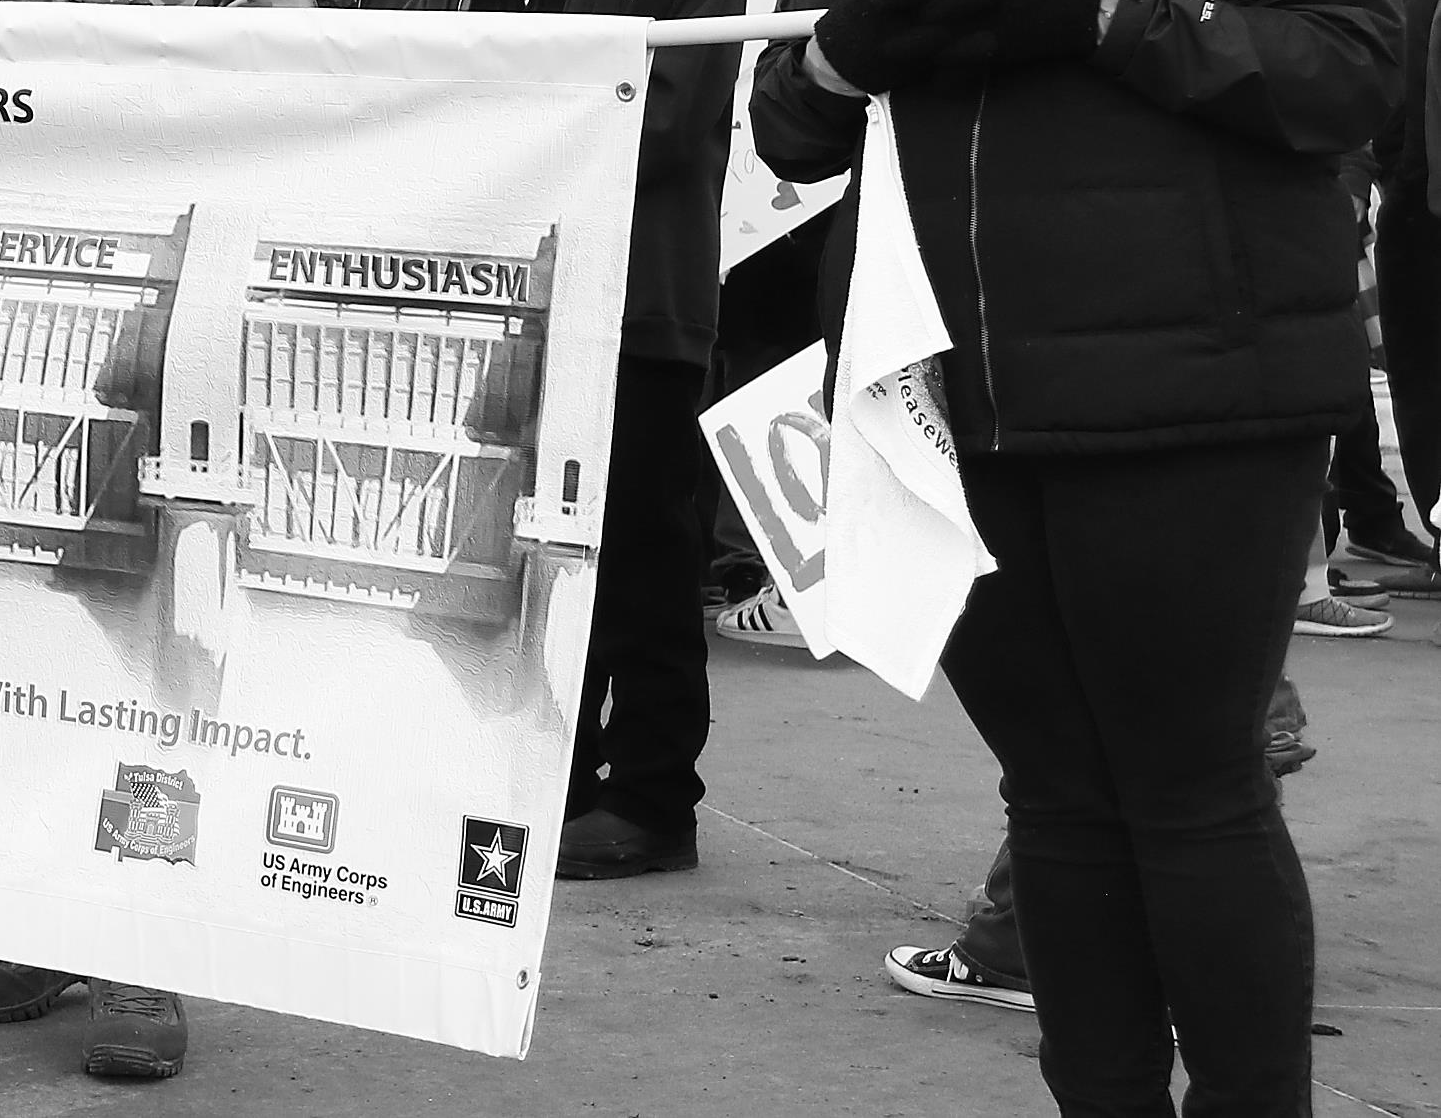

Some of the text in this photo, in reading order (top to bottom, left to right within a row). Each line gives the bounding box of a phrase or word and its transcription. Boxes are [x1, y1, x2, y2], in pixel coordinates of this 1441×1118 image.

[268, 247, 531, 303] ENTHUSIASM
[715, 389, 831, 593] LO
[59, 689, 182, 747] Lasting
[188, 709, 313, 761] Impact.
[133, 771, 184, 791] Tulsa District
[102, 817, 114, 834] US
[112, 829, 130, 849] Army
[129, 840, 149, 855] Corps
[159, 834, 196, 856] Engineers
[261, 873, 365, 905] of Engineers
[262, 852, 388, 891] US Army Corps
